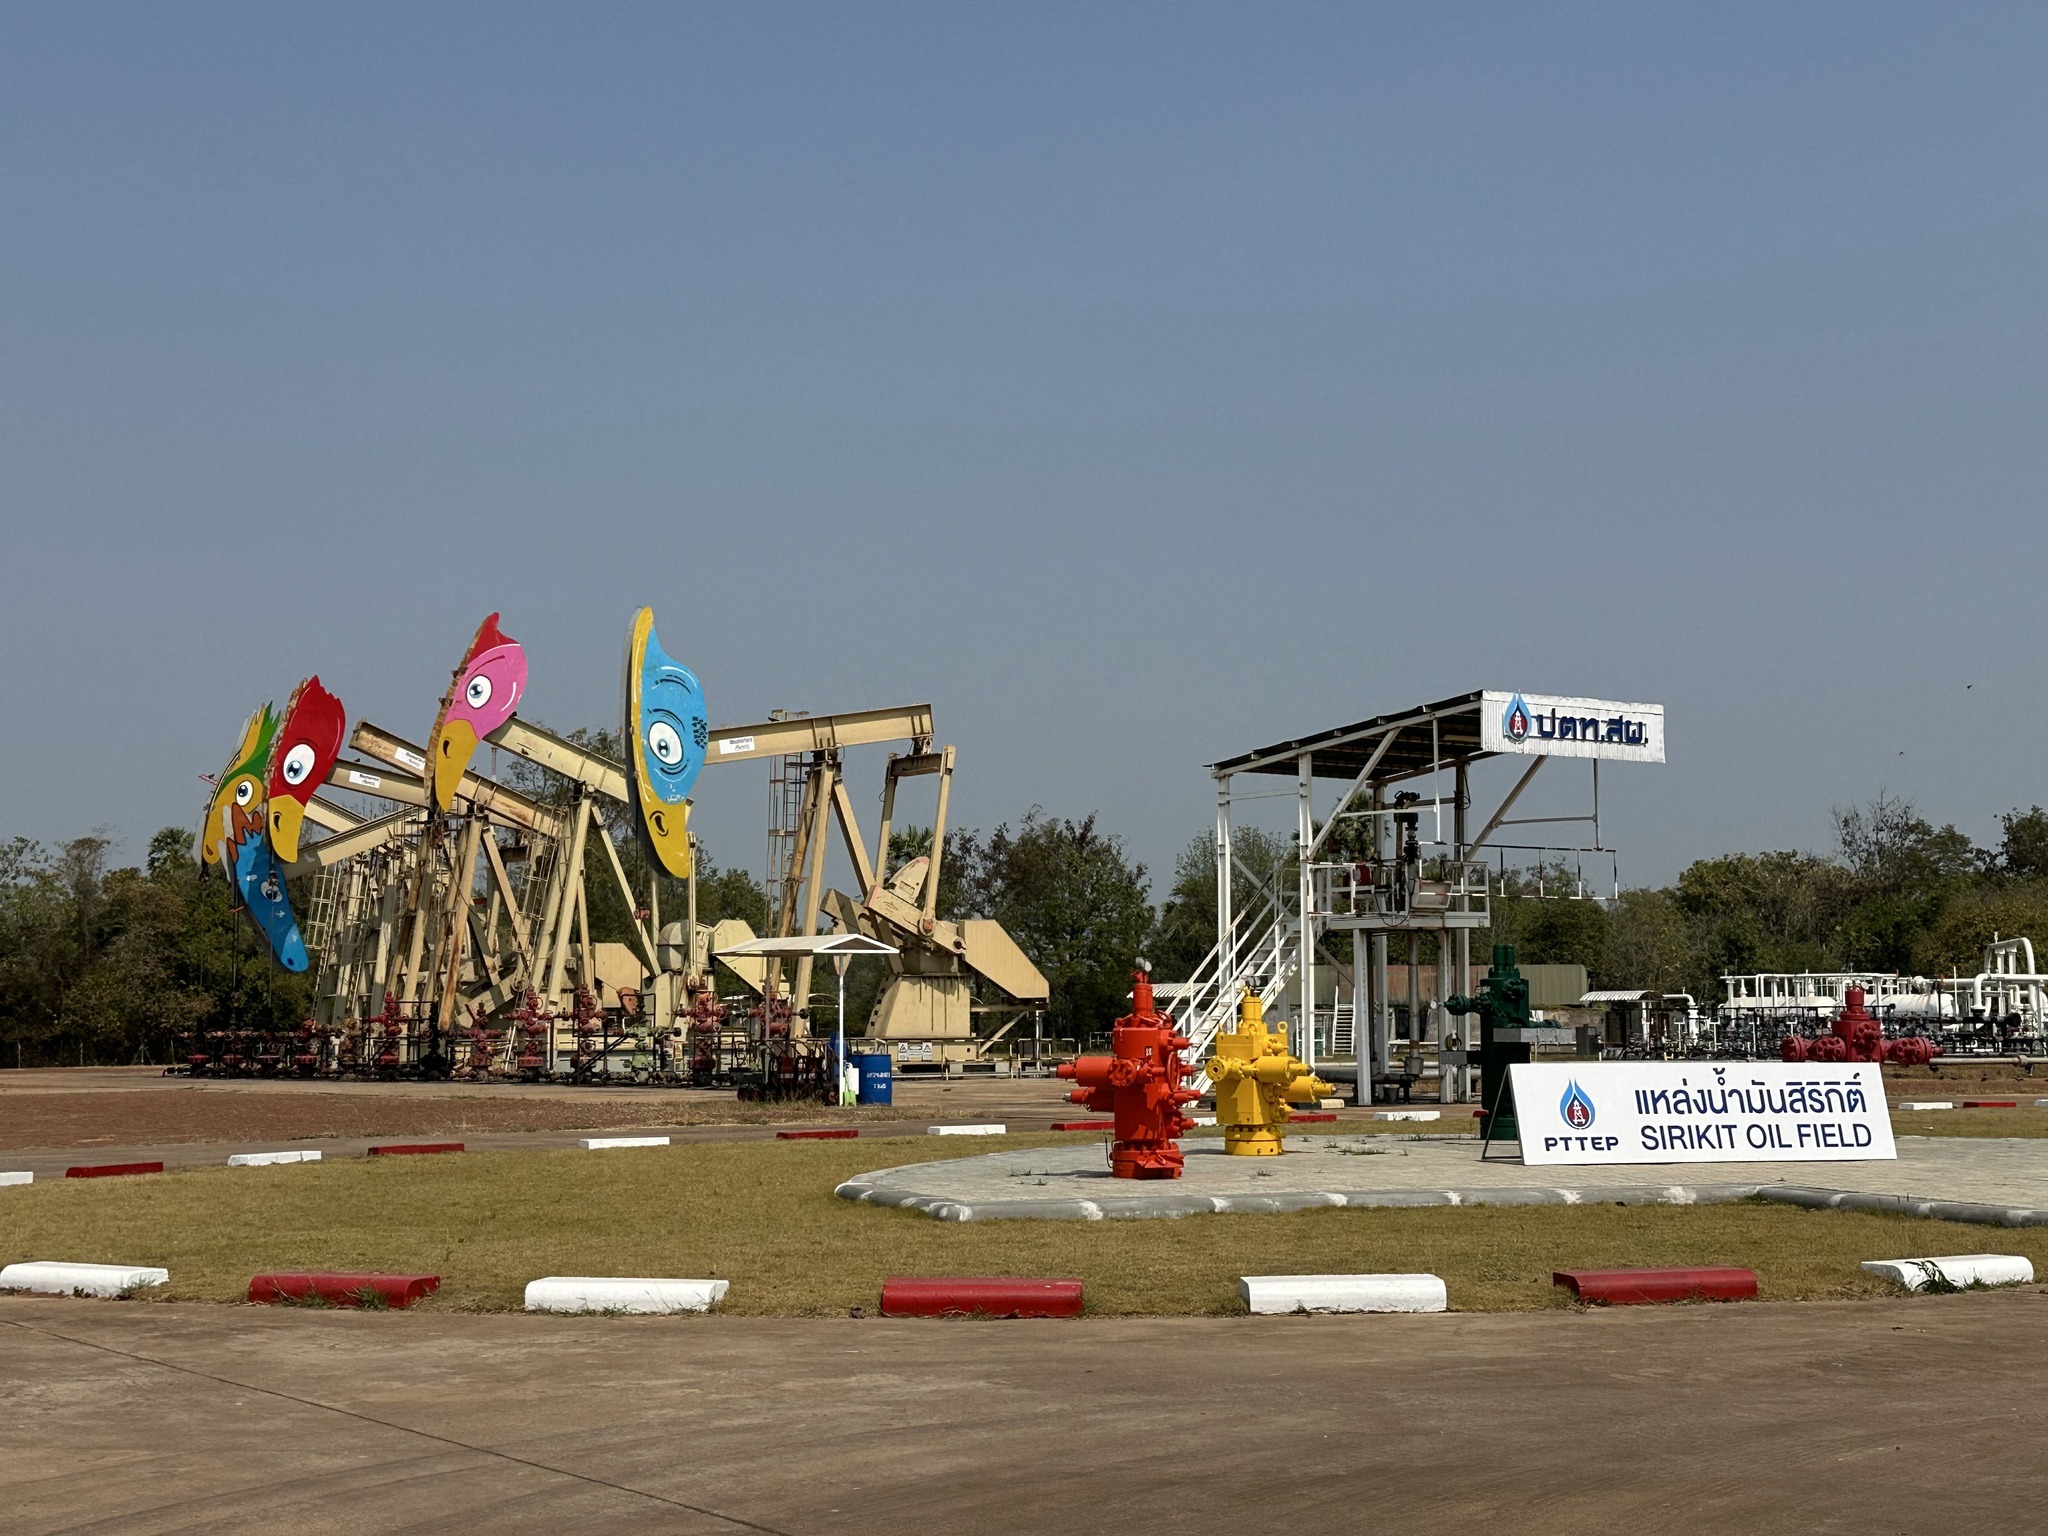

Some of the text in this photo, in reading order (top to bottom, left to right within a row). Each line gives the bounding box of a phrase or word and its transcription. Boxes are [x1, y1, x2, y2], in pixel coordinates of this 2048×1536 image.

[1634, 1067, 1868, 1115] แหล่งน้ำมันสิริกิติ์
[1544, 1136, 1620, 1152] PTTEP
[1640, 1123, 1873, 1151] SIRIKIT OIL FIELD
